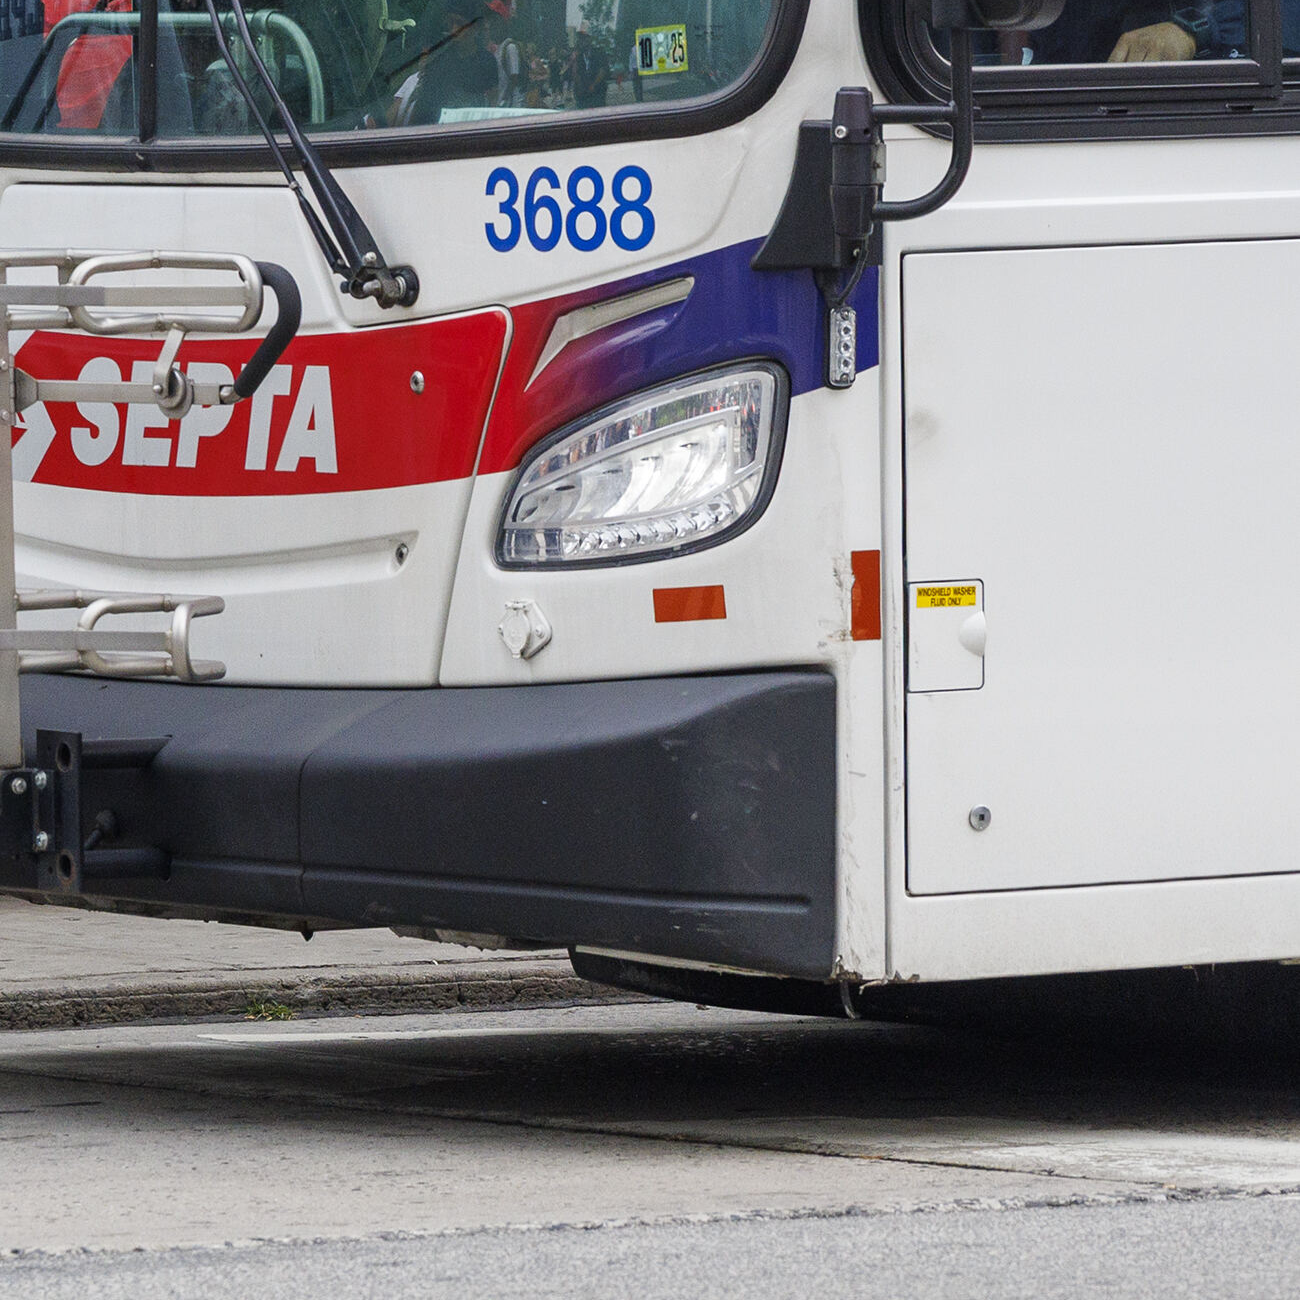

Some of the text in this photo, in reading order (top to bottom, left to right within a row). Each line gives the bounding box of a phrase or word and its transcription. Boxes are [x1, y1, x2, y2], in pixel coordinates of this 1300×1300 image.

[639, 32, 685, 68] 10 25
[484, 165, 655, 252] 3688
[70, 356, 338, 475] SEPTA
[917, 586, 976, 596] WINDSHIELD WASHER
[930, 597, 946, 607] FLUID
[947, 597, 962, 606] ONLY
